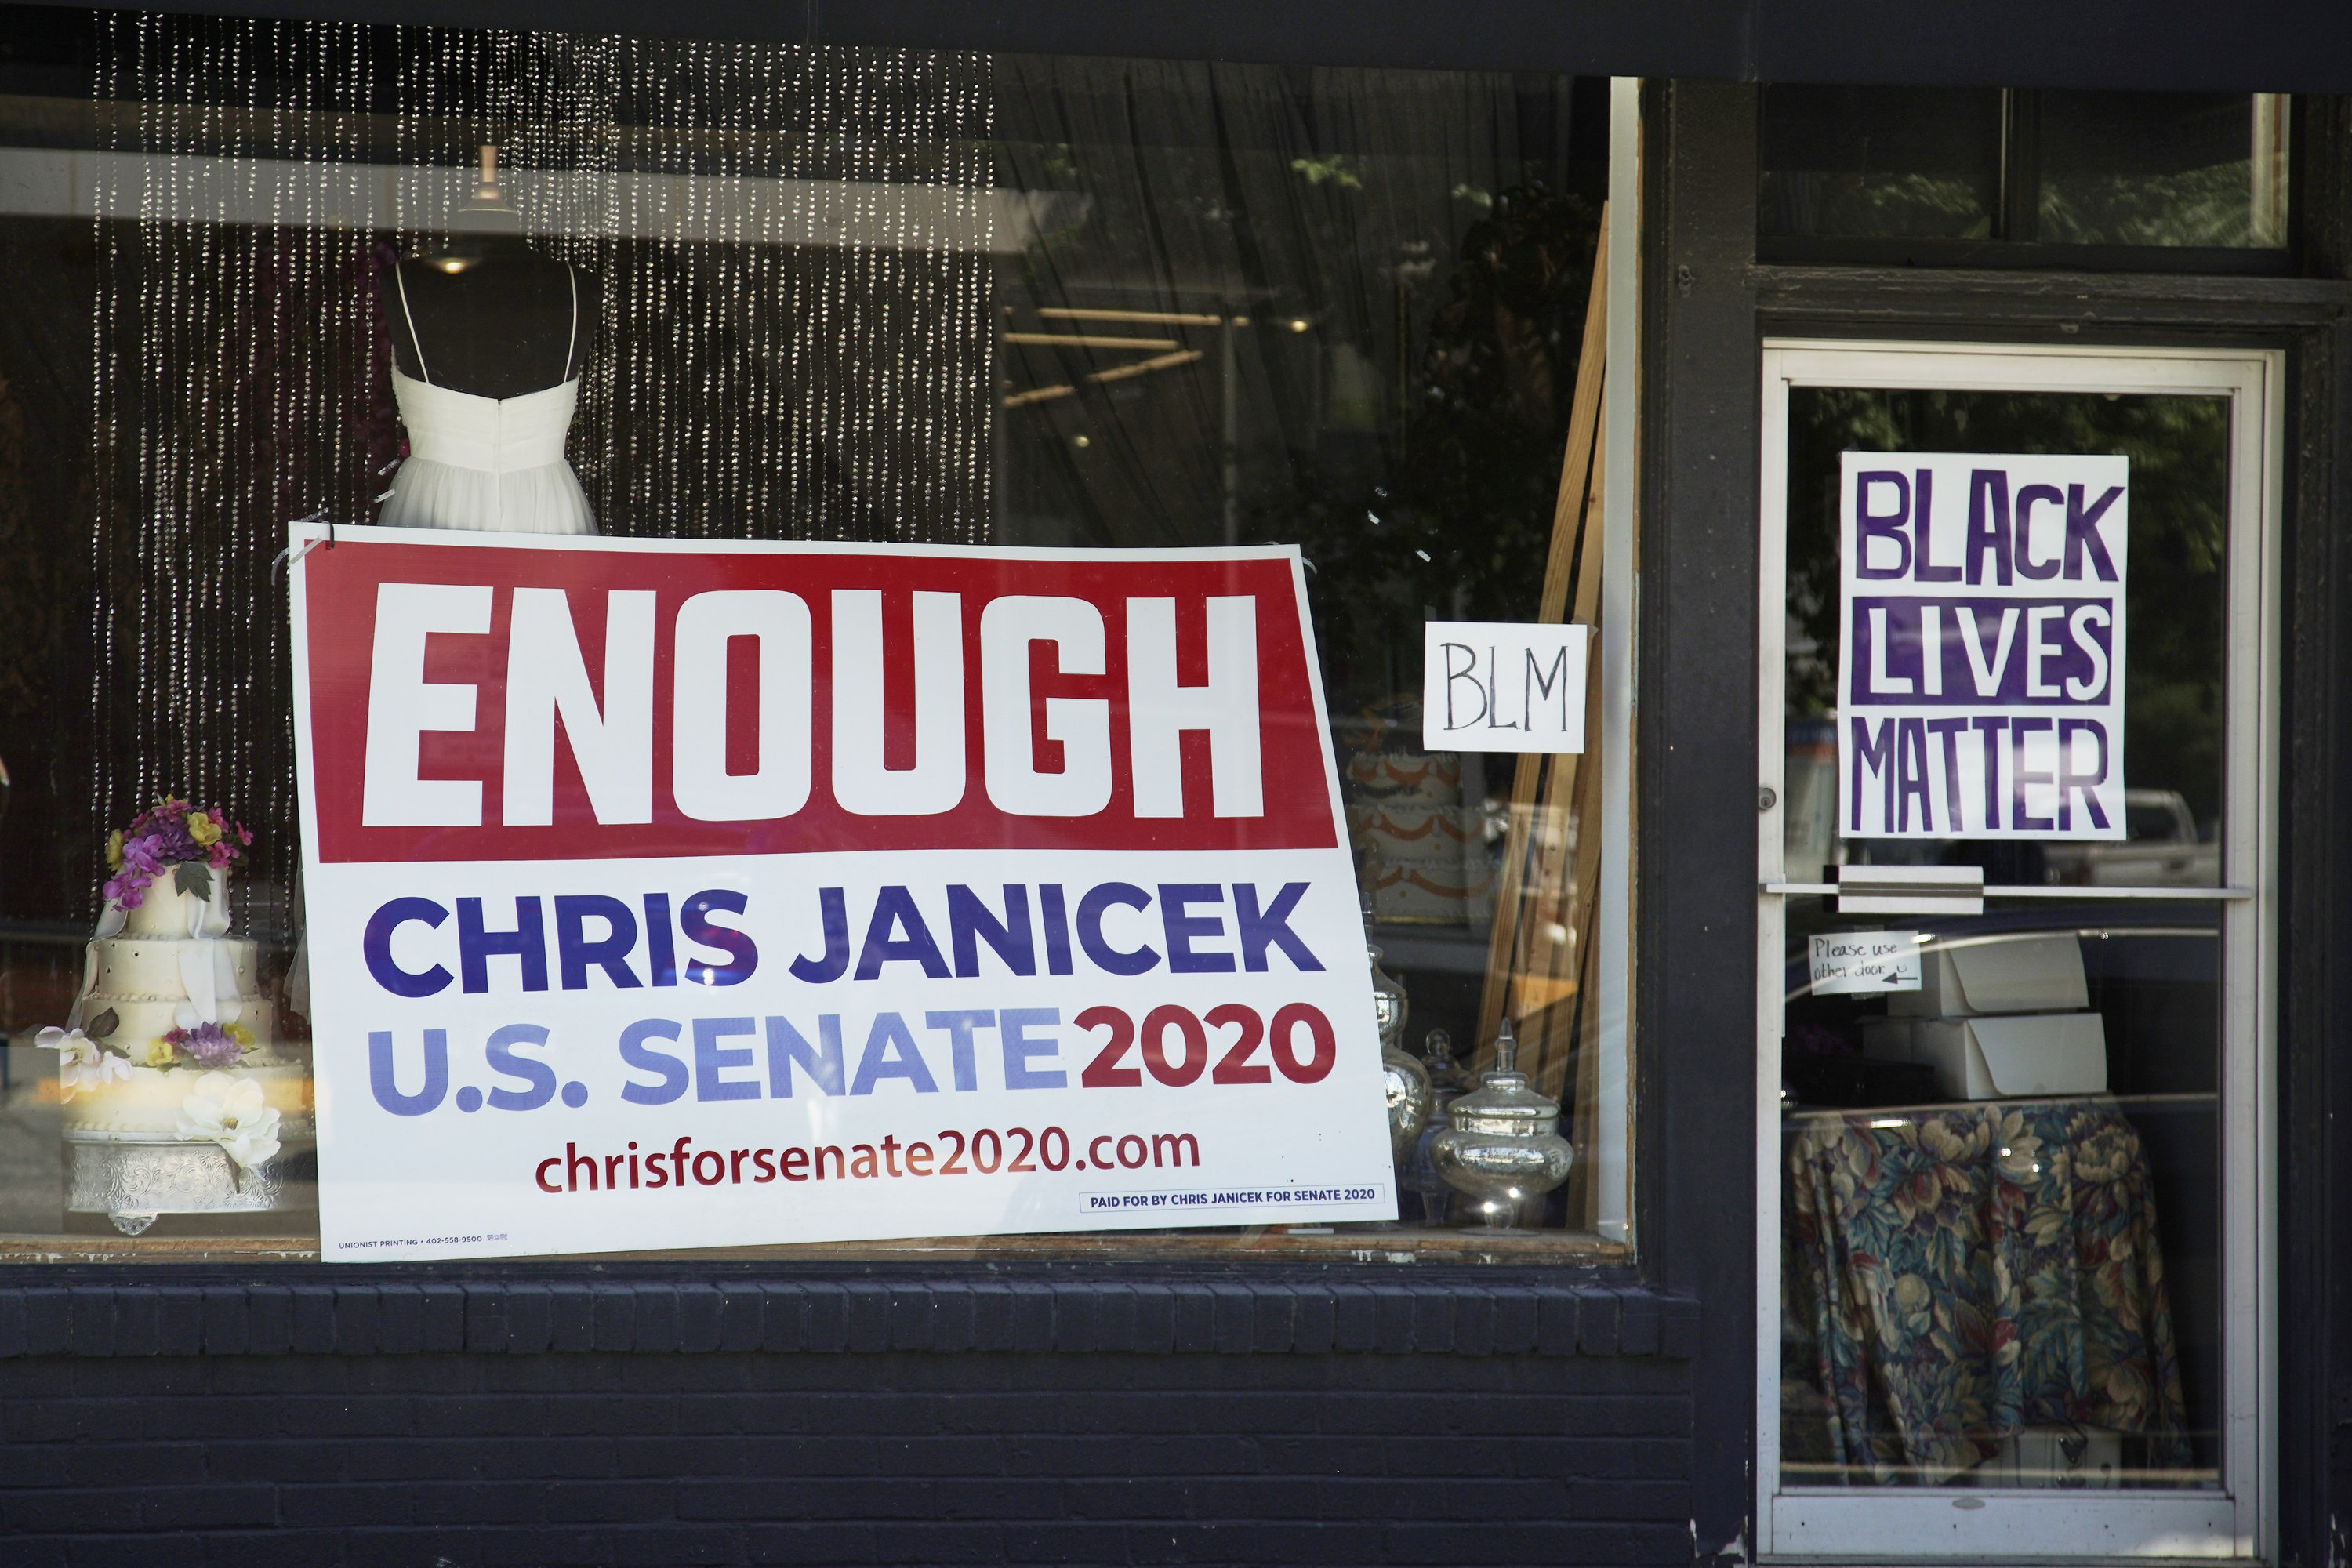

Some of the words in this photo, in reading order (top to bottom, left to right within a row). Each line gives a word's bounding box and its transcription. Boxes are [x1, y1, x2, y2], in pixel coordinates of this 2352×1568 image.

[1856, 469, 2125, 586] BLACK
[1439, 642, 1568, 732] BLM
[1869, 604, 2111, 701] LIVES
[362, 582, 1265, 828] ENOUGH
[1851, 716, 2111, 833] MATTER
[363, 888, 759, 998] CHRIS
[789, 881, 1327, 984] JANICEK
[1813, 963, 1848, 981] other
[1814, 938, 1867, 958] Please
[1872, 943, 1897, 956] use
[368, 1024, 589, 1117] U.S.
[619, 1007, 1068, 1106] SENATE
[1073, 1002, 1336, 1089] 2020
[535, 1126, 1200, 1194] chrisforsenate2020.com
[1091, 1196, 1120, 1208] PAID
[1123, 1196, 1149, 1207] FOR
[1152, 1195, 1167, 1205] BY
[1171, 1193, 1207, 1205] CHRIS
[1211, 1192, 1263, 1203] JANICEK
[1266, 1191, 1291, 1202] FOR
[1294, 1189, 1341, 1201] SENATE
[1344, 1189, 1375, 1200] 2020
[339, 1240, 378, 1249] UNIONIST
[426, 1236, 482, 1244] 402-558-9500
